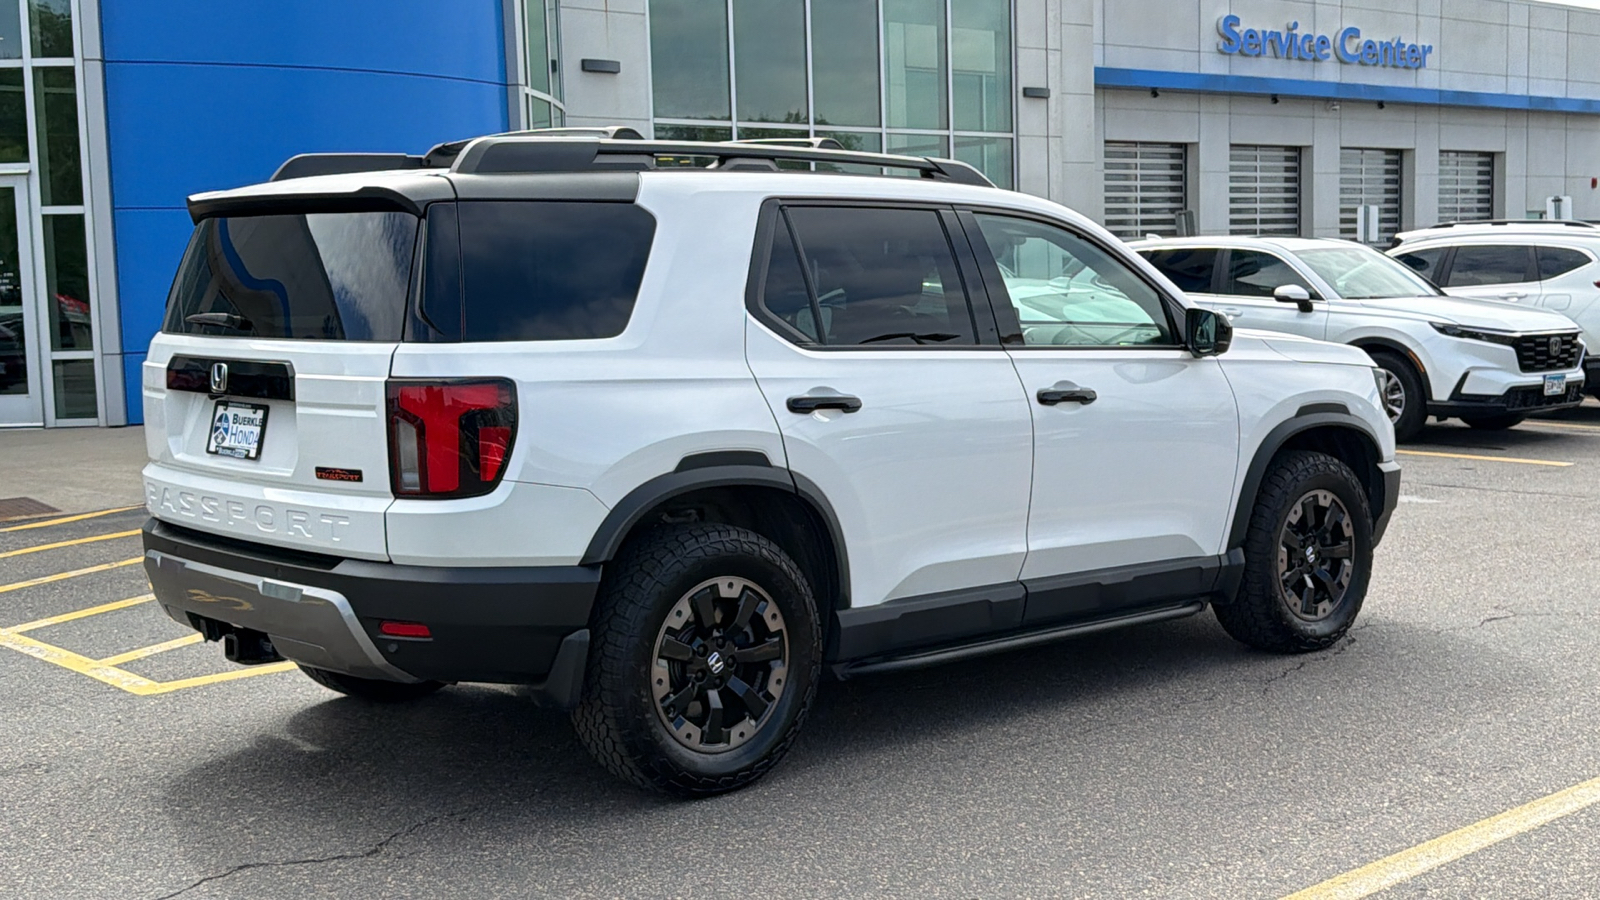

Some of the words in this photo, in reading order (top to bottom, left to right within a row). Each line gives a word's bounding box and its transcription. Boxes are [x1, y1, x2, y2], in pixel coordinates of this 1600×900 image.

[1217, 13, 1331, 61] Service
[1334, 26, 1433, 69] Center
[229, 425, 260, 446] HONDA
[232, 413, 263, 427] BUERKLE
[146, 481, 350, 542] PASSPORT
